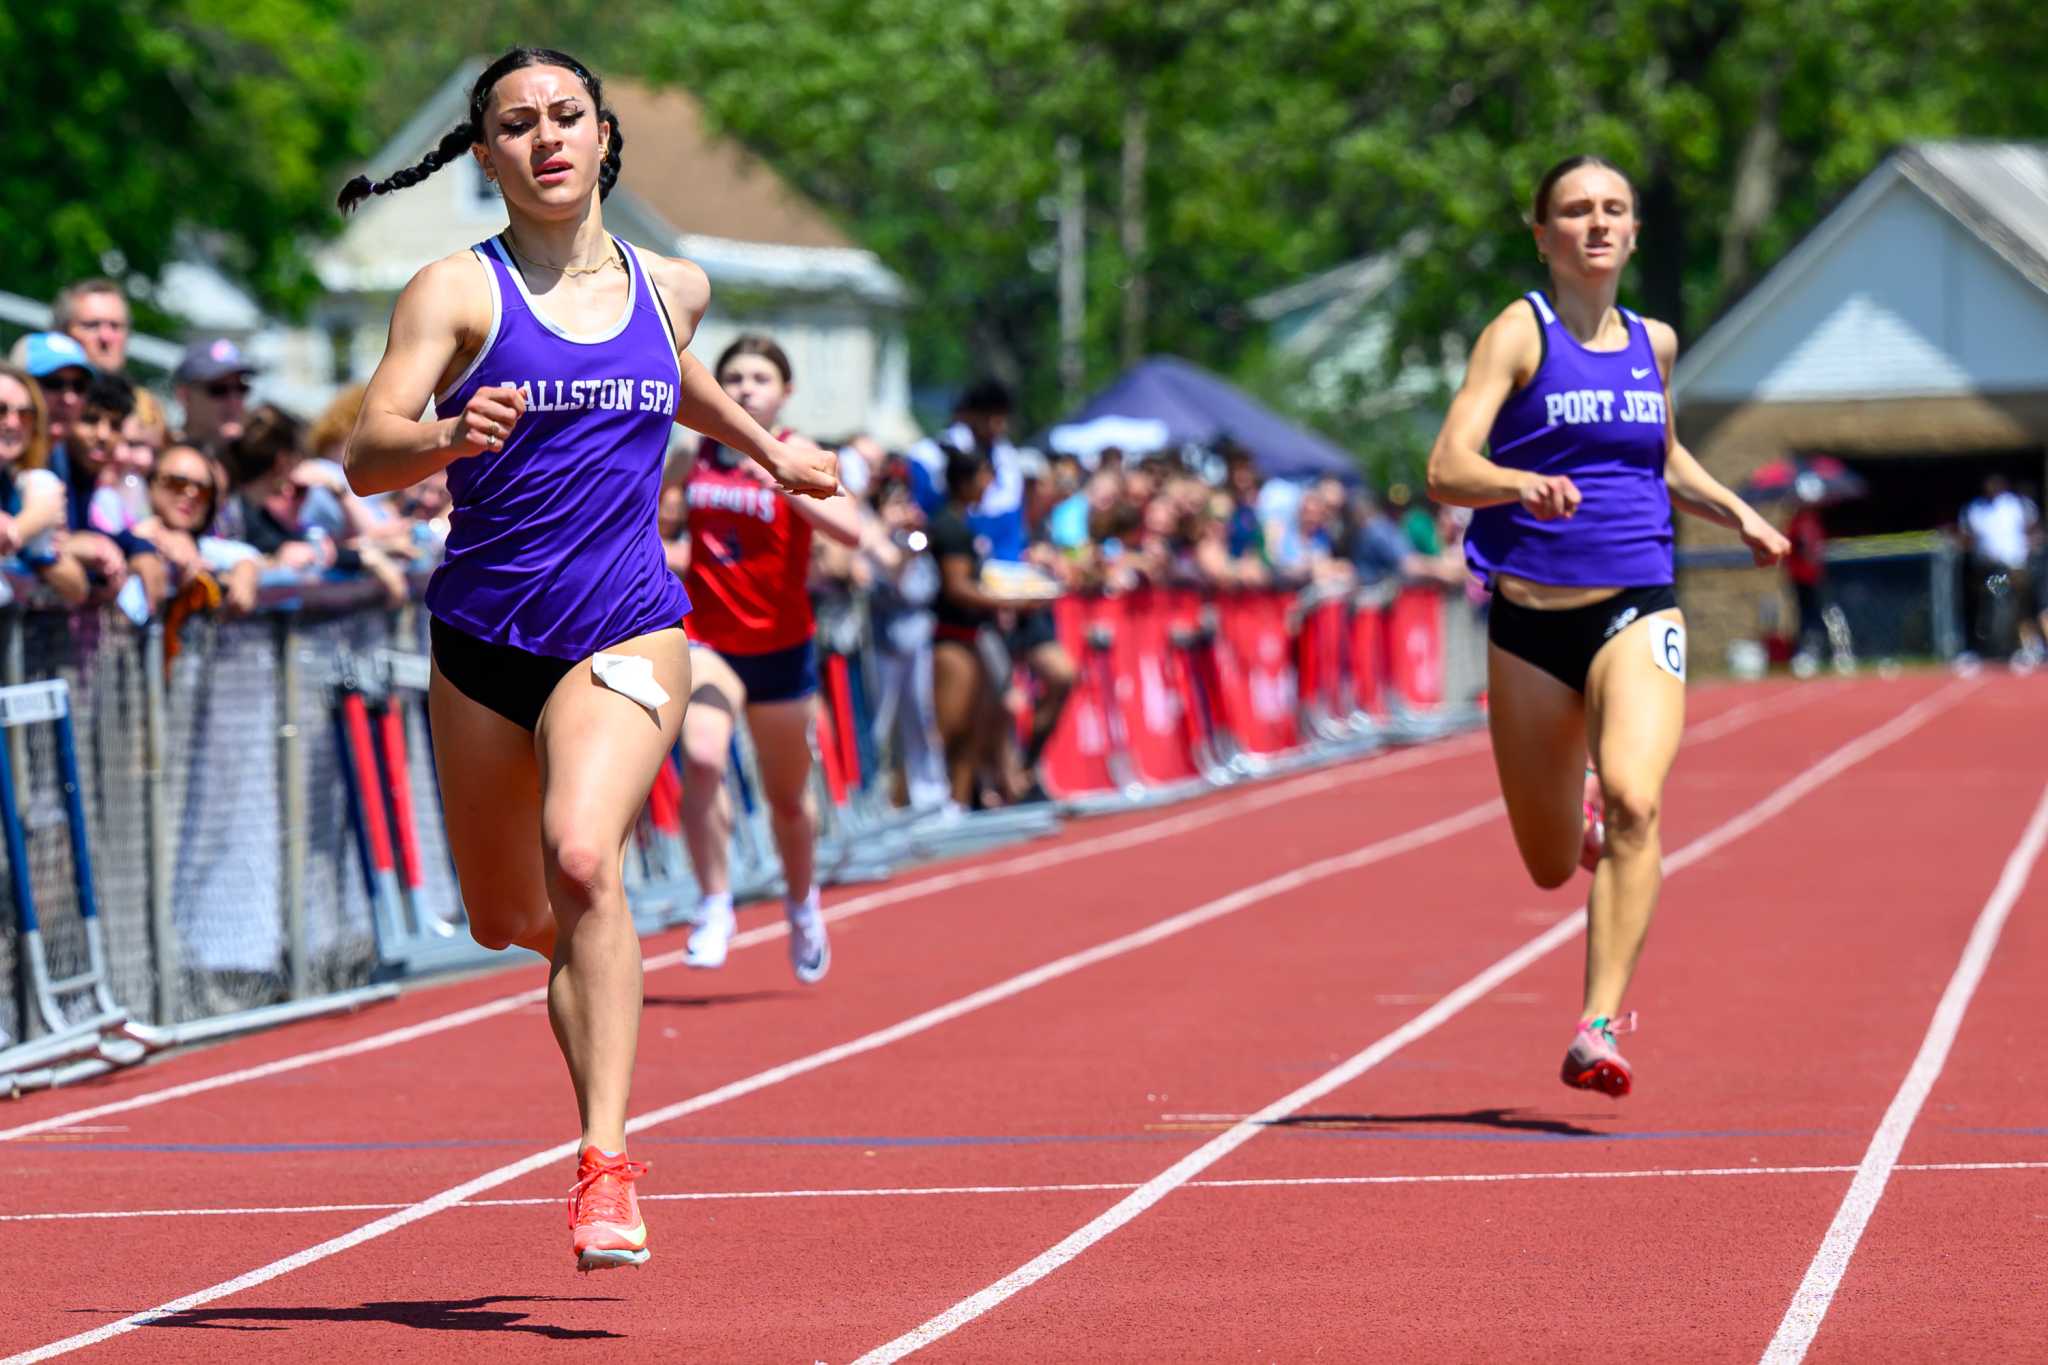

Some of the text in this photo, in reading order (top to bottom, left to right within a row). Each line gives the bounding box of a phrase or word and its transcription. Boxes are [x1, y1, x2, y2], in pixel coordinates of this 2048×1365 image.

[639, 378, 674, 415] SPA
[1545, 390, 1614, 426] PORT
[1664, 626, 1680, 673] 6
